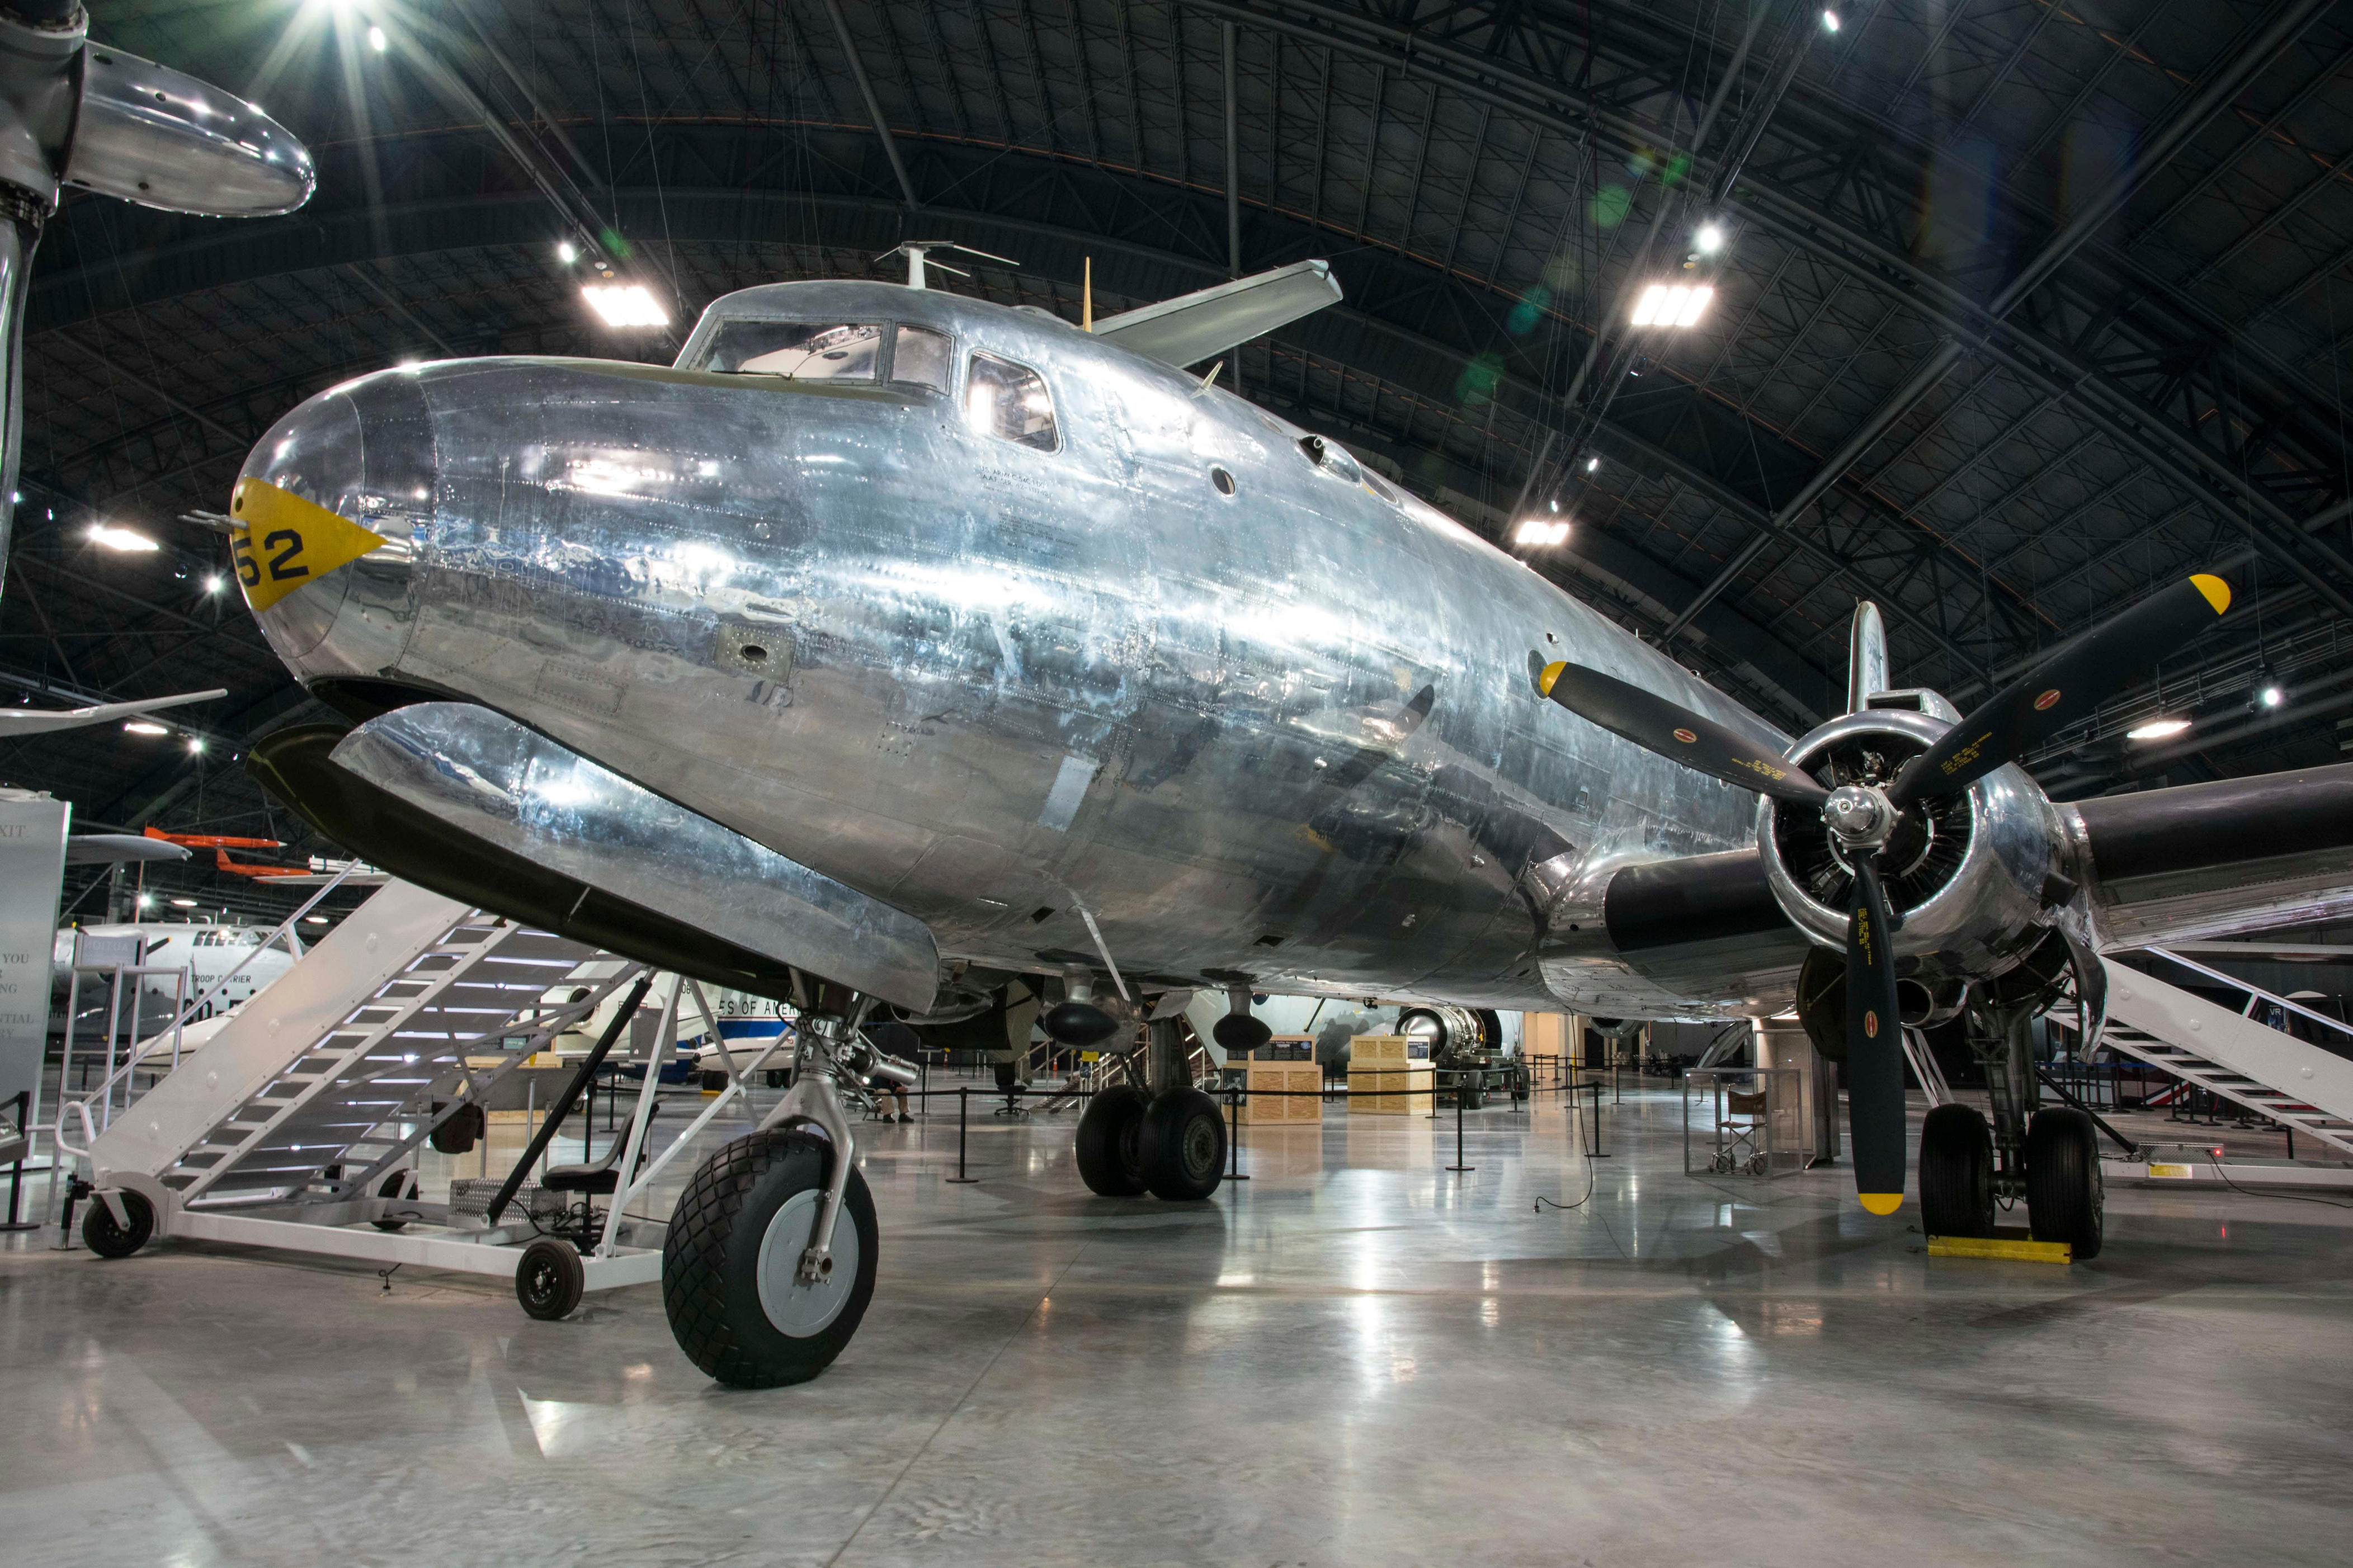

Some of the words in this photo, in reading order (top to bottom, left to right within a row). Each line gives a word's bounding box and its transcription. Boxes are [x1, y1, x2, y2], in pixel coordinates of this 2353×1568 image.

[233, 528, 309, 587] 52
[0, 825, 26, 837] XIT
[3, 953, 29, 964] YOU
[191, 974, 215, 983] TROOP
[218, 975, 252, 984] CRIER
[0, 983, 18, 994] NG
[719, 1000, 734, 1015] ES
[742, 1001, 757, 1015] OF
[0, 1013, 34, 1024] NTIAL
